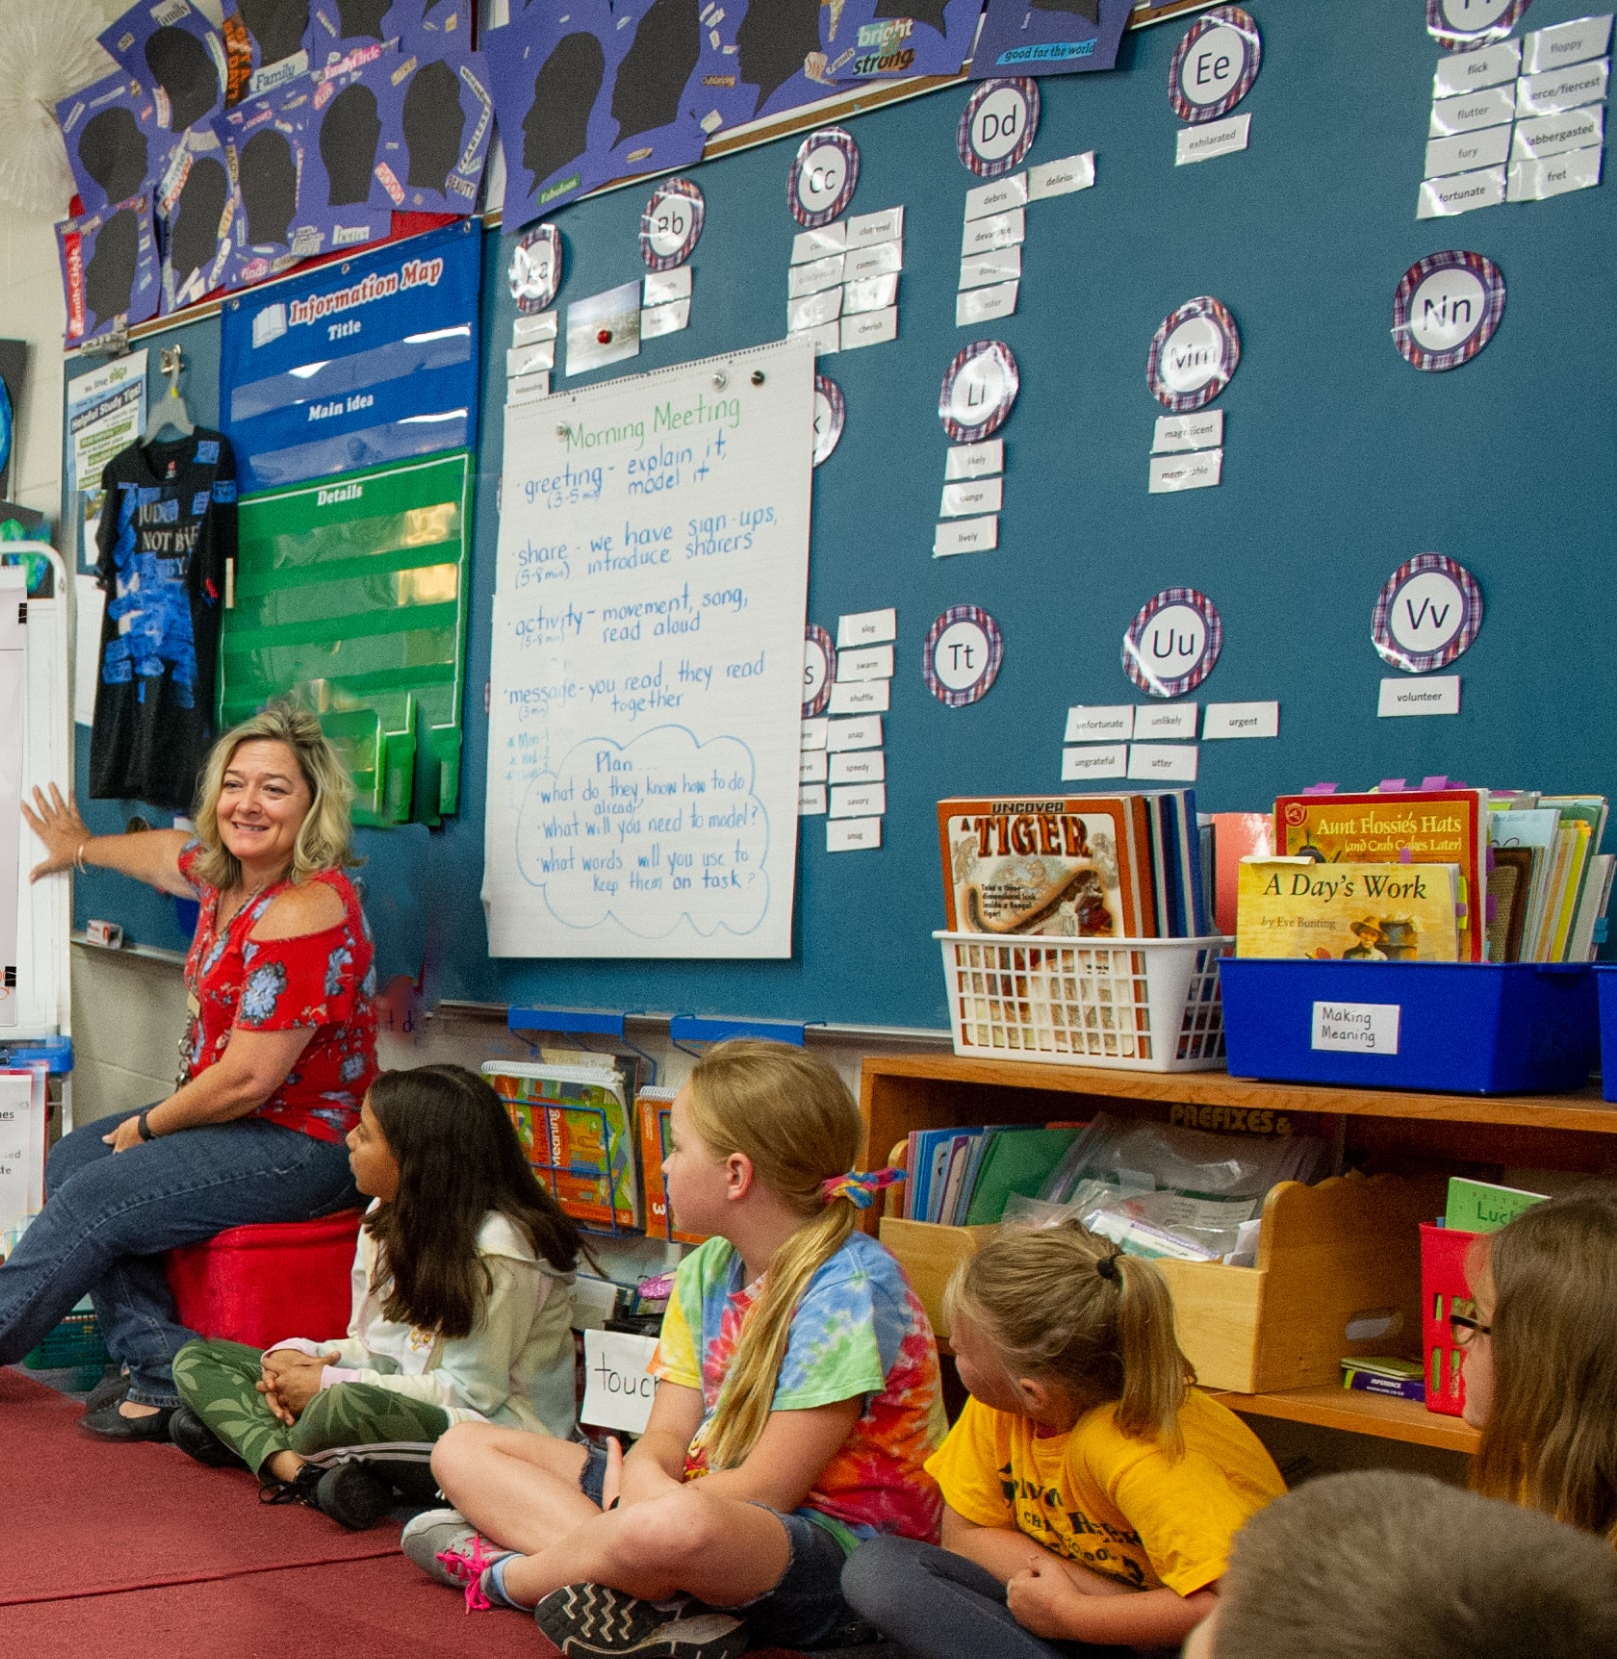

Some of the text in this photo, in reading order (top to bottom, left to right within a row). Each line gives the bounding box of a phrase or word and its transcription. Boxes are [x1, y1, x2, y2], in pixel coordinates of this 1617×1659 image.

[858, 20, 914, 46] bright
[1550, 39, 1583, 54] floppy
[1004, 45, 1066, 62] good for the
[256, 62, 296, 92] Family
[1196, 51, 1230, 85] Ee
[1467, 62, 1488, 75] flick
[981, 104, 1017, 143] Dd
[1457, 106, 1489, 120] flutter
[1189, 130, 1236, 149] exhilarated
[1458, 147, 1479, 159] fury
[1547, 169, 1567, 182] fret
[1439, 185, 1486, 202] fortunate
[289, 257, 444, 327] Information Map
[1423, 295, 1472, 331] Nn
[327, 319, 362, 341] Title
[308, 394, 374, 422] Main idea
[565, 393, 742, 453] Morning Meeting
[627, 441, 693, 477] explain
[317, 483, 364, 507] Details
[628, 469, 680, 496] model
[518, 521, 673, 568] share we have
[588, 530, 753, 576] introduce sharers
[602, 581, 749, 623] movement, song,
[1406, 597, 1451, 630] Vv
[603, 610, 701, 644] read aloud
[948, 643, 975, 671] Tt
[1152, 628, 1196, 658] Uu
[677, 658, 713, 691] they
[726, 650, 765, 679] read
[611, 690, 685, 722] together
[1396, 691, 1443, 703] volunteer
[1151, 714, 1183, 728] unlikely
[1229, 716, 1258, 729] urgent
[596, 750, 633, 774] Plan
[540, 768, 745, 806] what do they know how to do
[585, 816, 612, 836] will
[618, 818, 642, 844] you
[648, 806, 683, 833] need
[689, 801, 704, 828] to
[960, 814, 1093, 859] A TIGER
[1316, 810, 1463, 836] Aunt Flossie's Hats
[1368, 835, 1395, 851] Crab
[582, 849, 623, 871] words
[637, 842, 660, 868] will
[667, 850, 694, 877] you
[703, 852, 725, 868] use
[734, 839, 749, 864] to
[629, 868, 692, 891] them on
[1263, 873, 1429, 903] A Day's Work
[1260, 916, 1336, 931] by Eve Bunting
[1321, 1006, 1373, 1031] Making
[1320, 1025, 1377, 1049] Meaning
[1169, 1103, 1274, 1134] PREFIXES
[594, 1351, 660, 1398] touc
